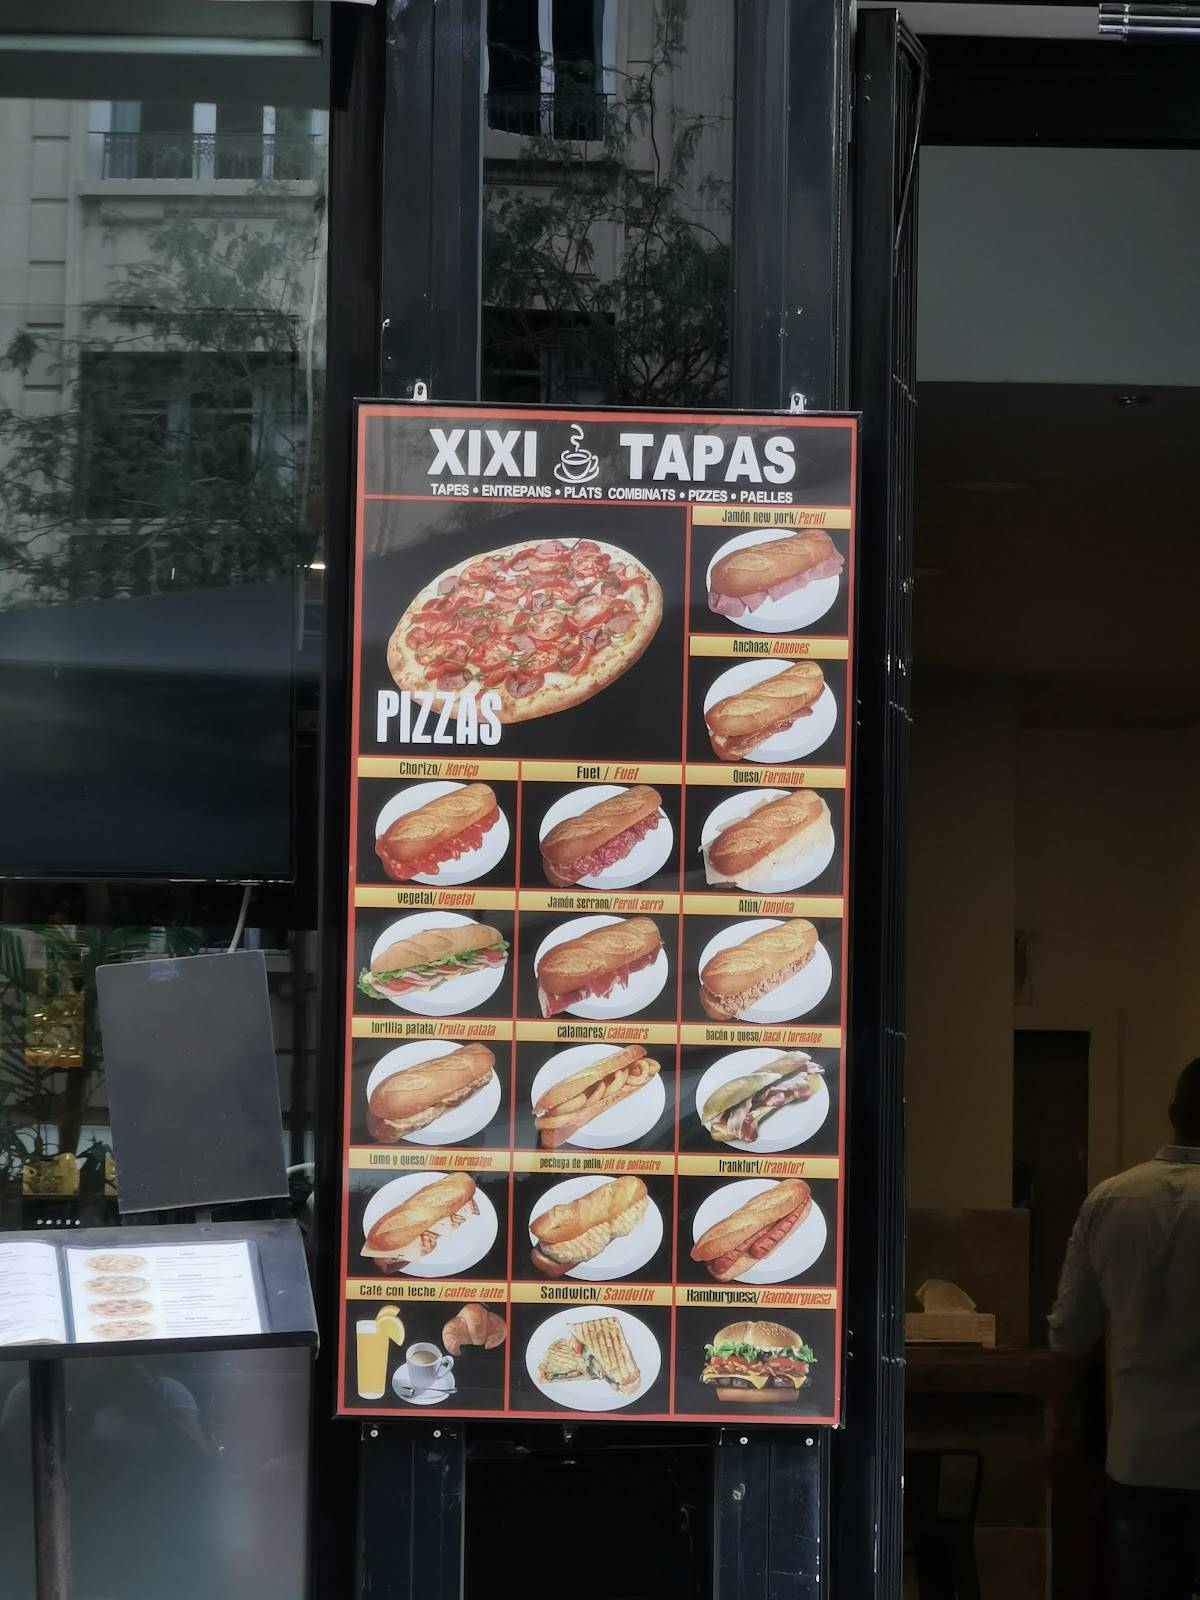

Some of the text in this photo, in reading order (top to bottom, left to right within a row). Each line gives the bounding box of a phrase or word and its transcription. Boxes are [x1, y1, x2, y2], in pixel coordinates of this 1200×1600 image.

[427, 429, 796, 484] XIXI TAPAS
[430, 483, 793, 504] TAPES ENTREPANS PLATS COMBINATS PIZZES PAELLES
[722, 510, 750, 523] Jamón
[753, 512, 771, 523] new
[376, 689, 503, 746] PIZZAS
[577, 766, 600, 780] Fuet
[613, 767, 640, 781] Fuet
[547, 896, 574, 908] Jamón
[371, 1022, 403, 1035] tortilla
[466, 1025, 497, 1038] patata
[369, 1153, 391, 1165] Lomo
[572, 1158, 581, 1168] de
[360, 1285, 382, 1298] Café
[385, 1287, 405, 1298] con
[407, 1286, 436, 1298] leche
